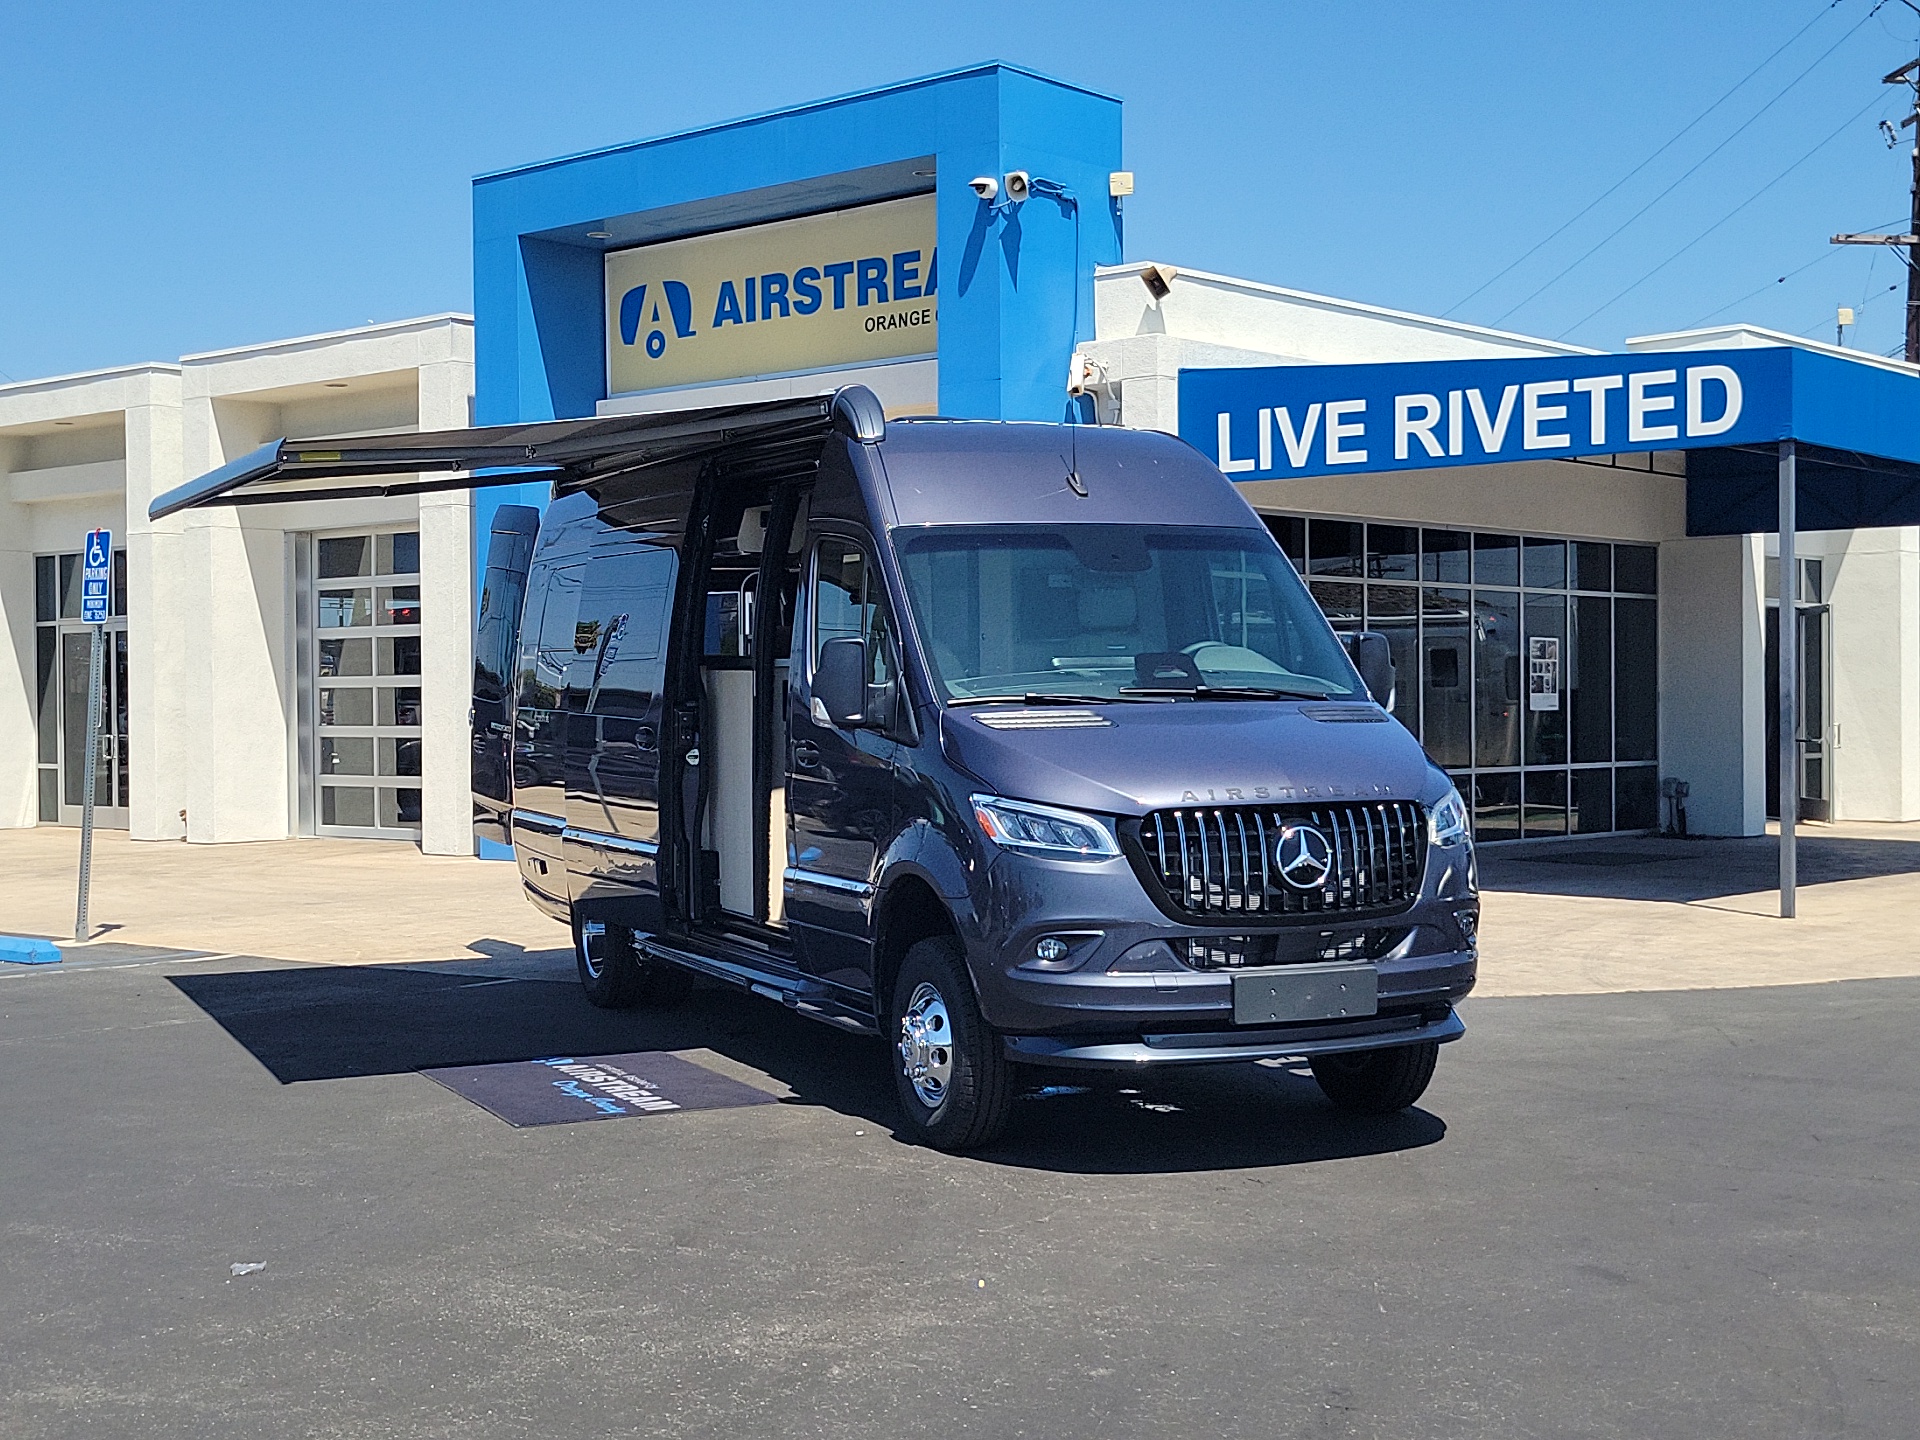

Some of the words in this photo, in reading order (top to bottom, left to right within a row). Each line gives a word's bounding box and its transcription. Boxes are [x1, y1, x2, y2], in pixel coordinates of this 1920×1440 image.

[864, 308, 931, 333] ORANGE
[1217, 399, 1368, 473] LIVE
[1394, 364, 1743, 460] RIVETED
[85, 567, 107, 580] PARKING
[88, 582, 103, 595] ONLY
[1181, 784, 1394, 803] AIRSTREAM
[552, 1064, 681, 1111] AIRSTREAM
